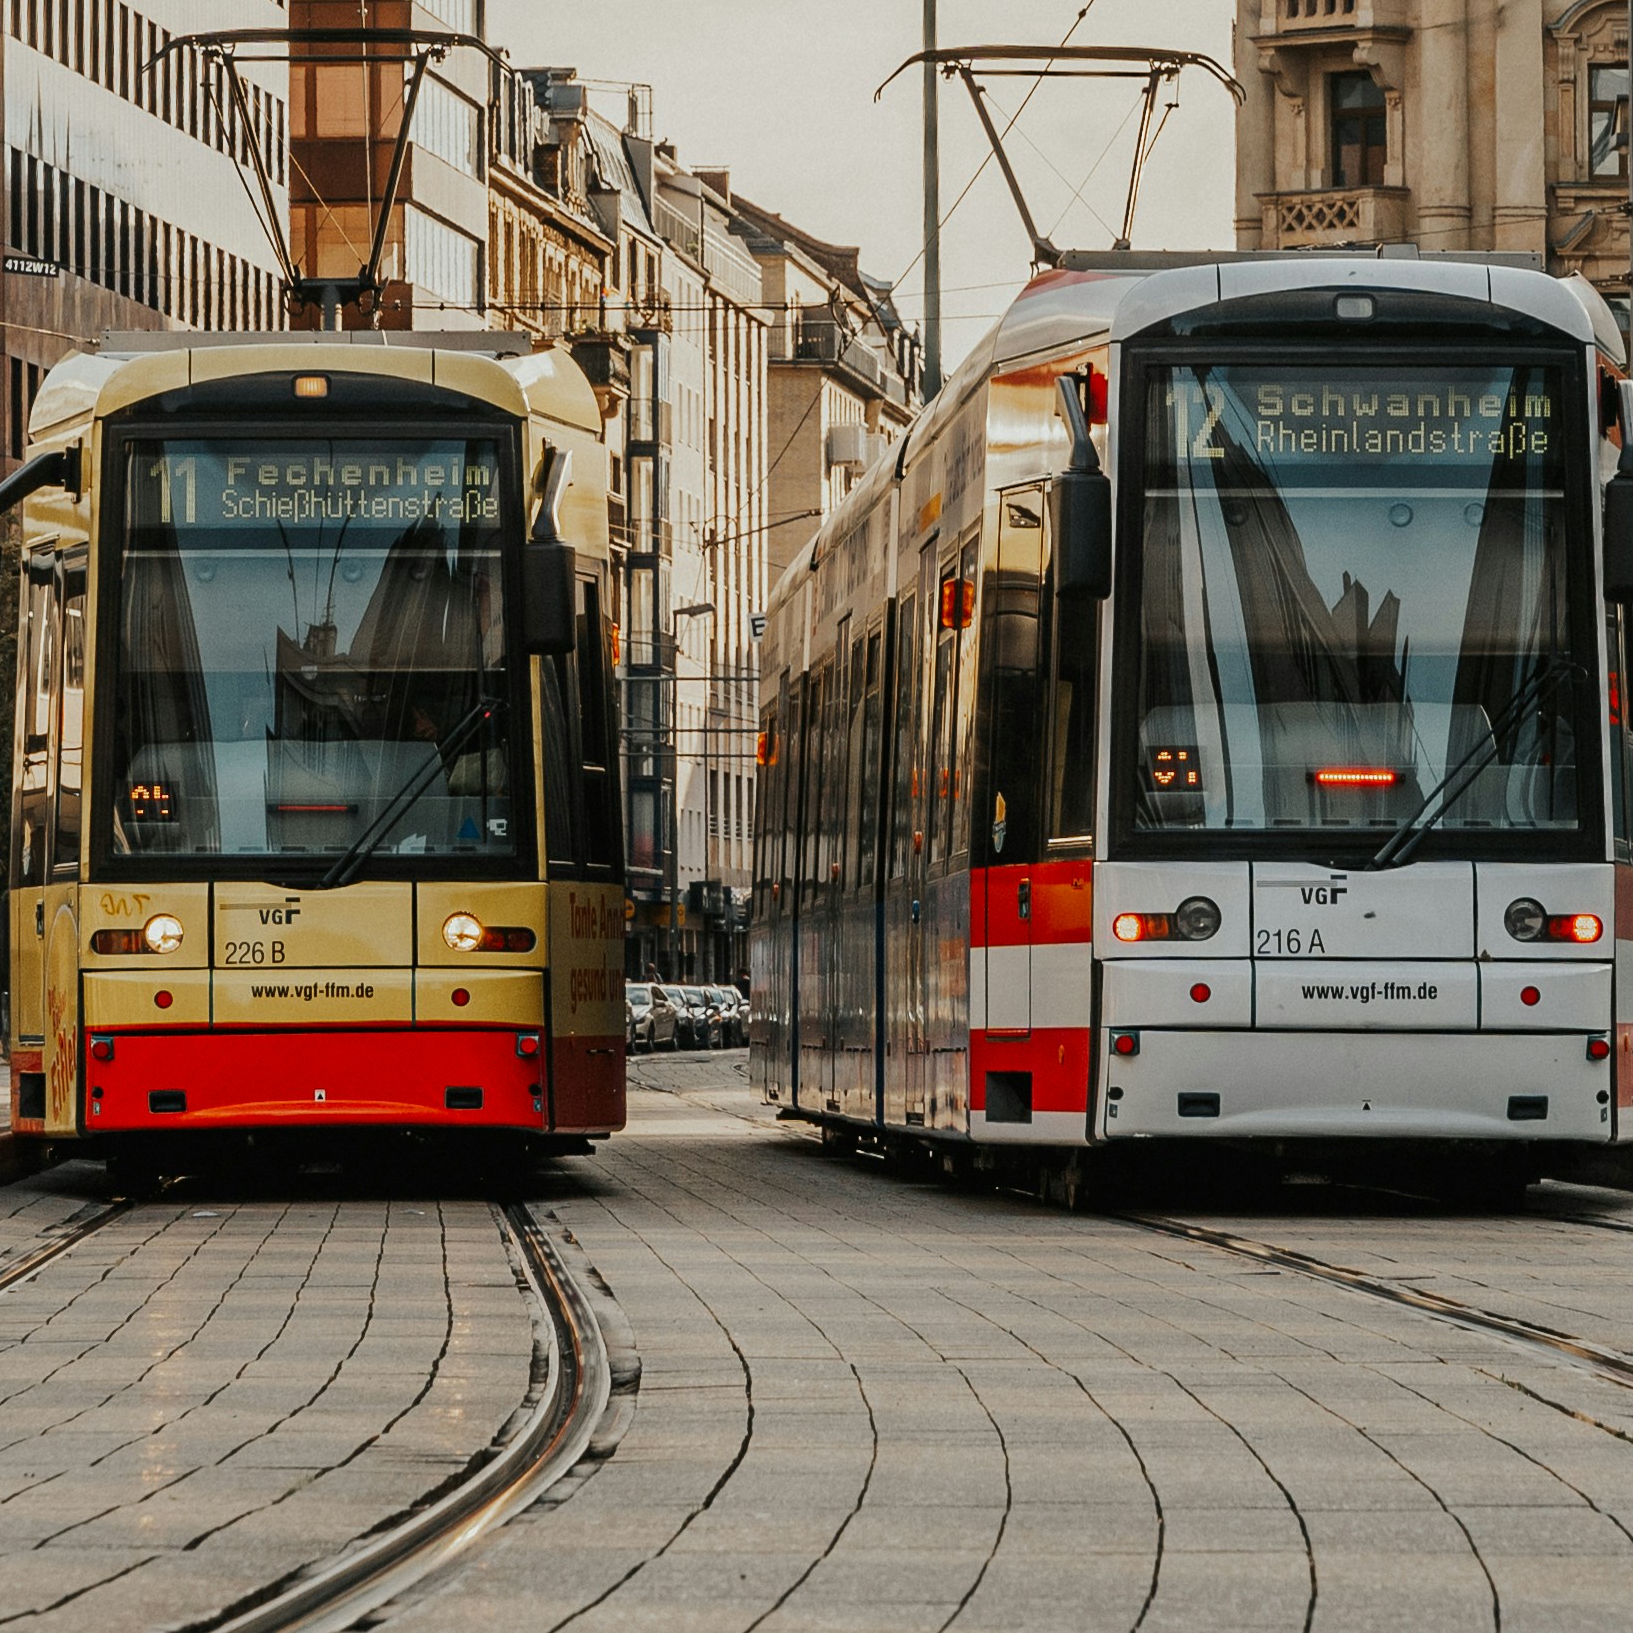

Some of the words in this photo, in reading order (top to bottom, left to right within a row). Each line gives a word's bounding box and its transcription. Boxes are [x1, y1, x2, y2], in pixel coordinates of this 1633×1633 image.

[5, 259, 56, 275] 4112W12
[1166, 383, 1224, 458] 12
[1258, 385, 1550, 417] Schwanheim
[1258, 420, 1548, 459] Rheinlandstraße
[150, 457, 195, 523] 11
[228, 457, 489, 485] Fechenheim
[221, 489, 498, 524] Schießhüttenstraße
[1301, 875, 1347, 904] VGF
[259, 897, 301, 924] VGF
[224, 941, 265, 964] 226
[271, 941, 286, 964] B
[1256, 928, 1301, 954] 216
[1308, 928, 1326, 954] A
[251, 982, 374, 1002] www.vgf-ffm.de
[1301, 981, 1438, 1004] www.vgf-ffm.de
